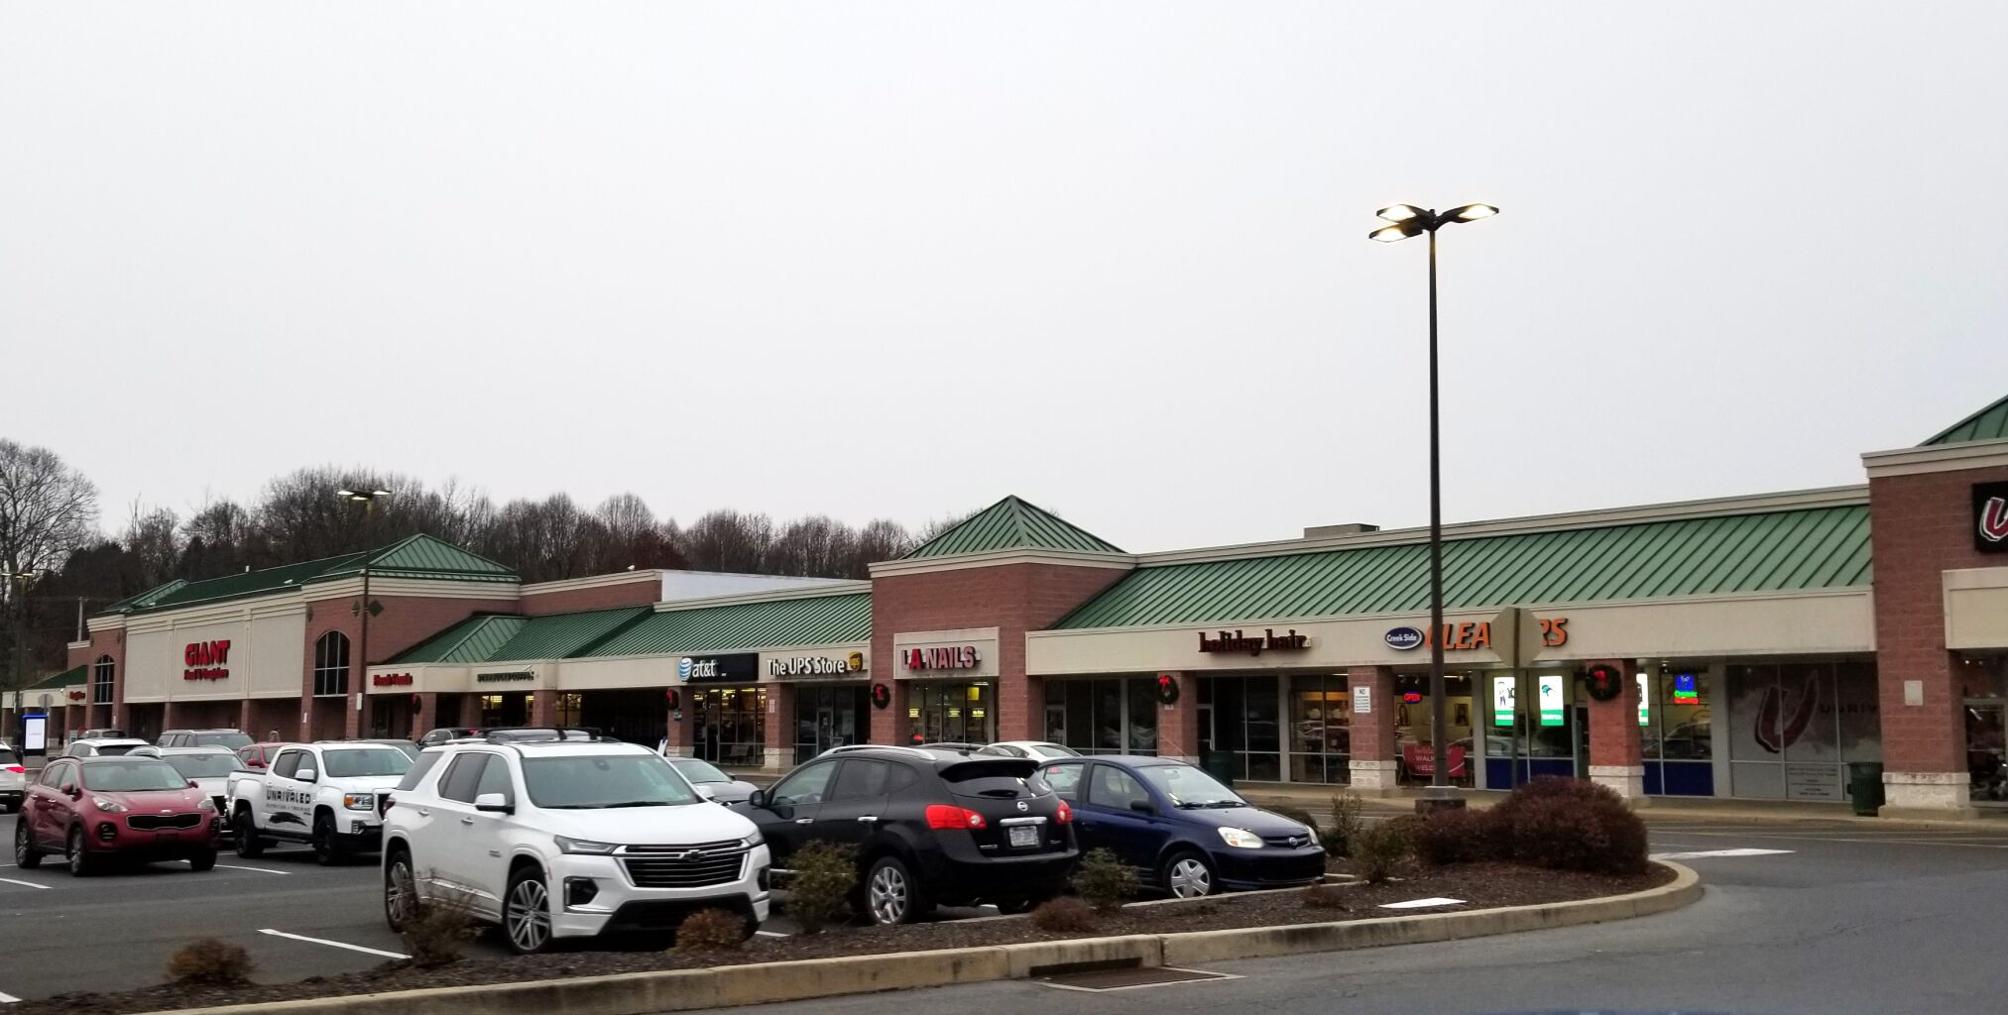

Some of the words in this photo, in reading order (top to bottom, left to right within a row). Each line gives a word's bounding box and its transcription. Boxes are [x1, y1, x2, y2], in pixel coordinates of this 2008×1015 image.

[1198, 630, 1265, 656] holiday
[1265, 629, 1308, 651] hair
[1386, 634, 1403, 642] Creek
[1403, 633, 1417, 642] Side
[1424, 618, 1568, 649] LEARS
[185, 640, 231, 667] GIANT
[926, 646, 977, 669] NAILS
[692, 659, 717, 678] at&t
[767, 659, 787, 676] The
[789, 657, 812, 675] UPS
[812, 656, 846, 674] Store
